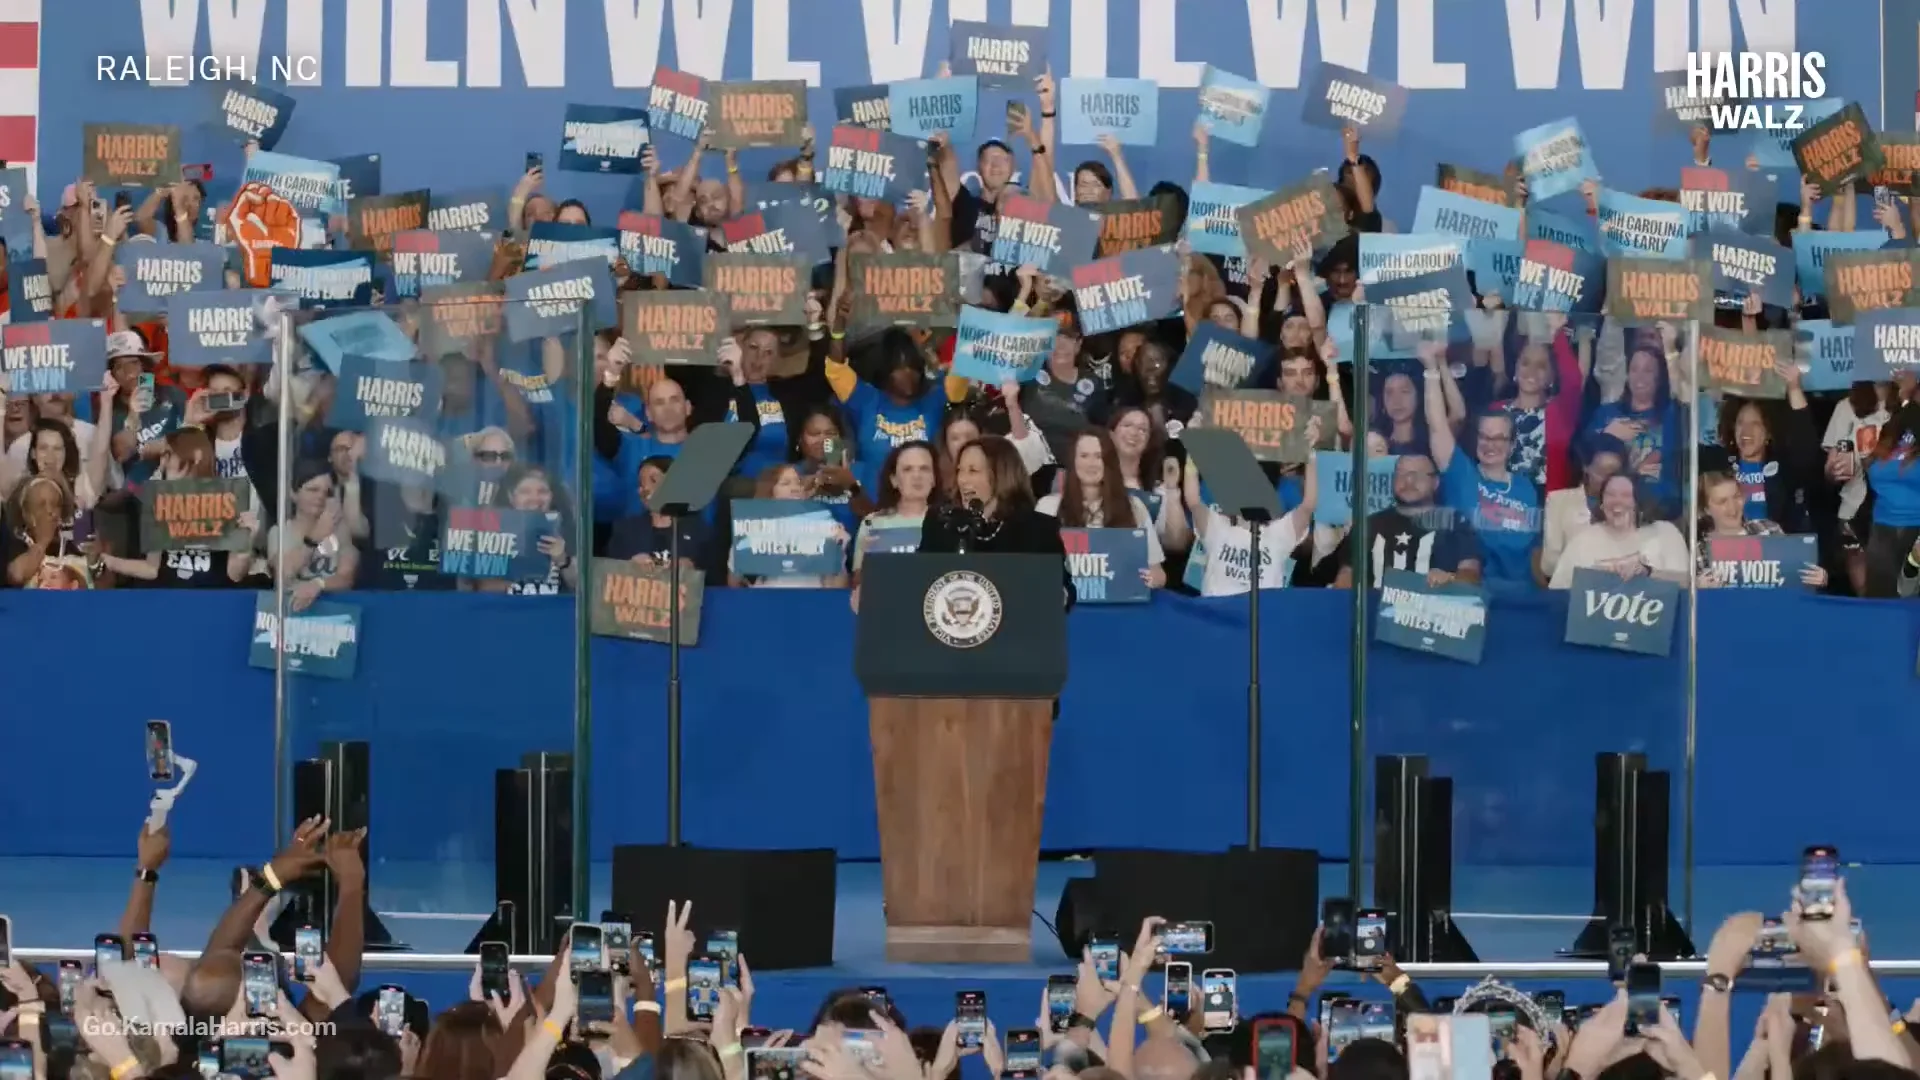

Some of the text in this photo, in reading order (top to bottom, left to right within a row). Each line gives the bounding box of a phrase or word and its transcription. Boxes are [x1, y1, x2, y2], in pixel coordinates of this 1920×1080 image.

[967, 36, 1030, 62] HARRIS
[976, 59, 1020, 76] WALZ
[222, 88, 279, 127] HARRIS
[721, 92, 796, 120] HARRIS
[908, 93, 963, 118] HARRIS
[1080, 92, 1140, 116] HARRIS
[1326, 79, 1386, 115] HARRIS
[918, 116, 956, 131] WALZ
[1087, 114, 1132, 128] WALZ
[1330, 102, 1371, 125] WALZ
[733, 119, 784, 136] WALZ
[97, 133, 169, 159] HARRIS
[1801, 119, 1863, 171] HARRIS
[105, 158, 159, 175] WALZ
[828, 147, 855, 170] WE
[1817, 147, 1863, 181] WALZ
[1191, 200, 1230, 219] NORTH
[1681, 189, 1706, 211] WE
[1000, 214, 1023, 241] WE
[1104, 209, 1163, 241] ARRIS
[1626, 213, 1684, 237] CAROLINA
[1633, 233, 1669, 253] EARLY
[136, 258, 203, 284] HARRIS
[394, 252, 417, 275] WE
[1361, 252, 1401, 269] NORTH
[1712, 243, 1777, 276] HARRIS
[716, 266, 796, 294] HARRIS
[864, 266, 945, 296] HARRIS
[1520, 258, 1547, 287] WE
[1721, 264, 1765, 286] WALZ
[1837, 261, 1913, 296] HARRIS
[1076, 283, 1106, 312] WE
[1621, 271, 1699, 301] HARRIS
[535, 301, 581, 318] WAL
[731, 293, 786, 311] WALZ
[877, 295, 934, 313] WALZ
[1634, 299, 1688, 318] WALZ
[1850, 290, 1904, 309] WALZ
[188, 307, 253, 333] HARRIS
[636, 305, 718, 334] HARRIS
[199, 331, 248, 347] WALZ
[649, 332, 705, 351] WALZ
[1820, 335, 1854, 360] HAR
[1874, 324, 1920, 349] HARR
[4, 345, 28, 369] WE
[1700, 335, 1776, 369] HARRIS
[1708, 360, 1763, 386] WALZ
[1831, 359, 1854, 373] WA
[356, 375, 425, 407] HARRIS
[1213, 400, 1296, 430] HARRIS
[155, 492, 237, 521] HARRIS
[167, 519, 224, 538] WALZ
[447, 527, 475, 551] WE
[1069, 552, 1115, 580] VOTE,
[1218, 542, 1274, 568] HARS
[1224, 565, 1266, 581] WAZ
[1711, 560, 1738, 584] WE
[603, 573, 689, 613] HARRS
[1584, 588, 1665, 627] vote
